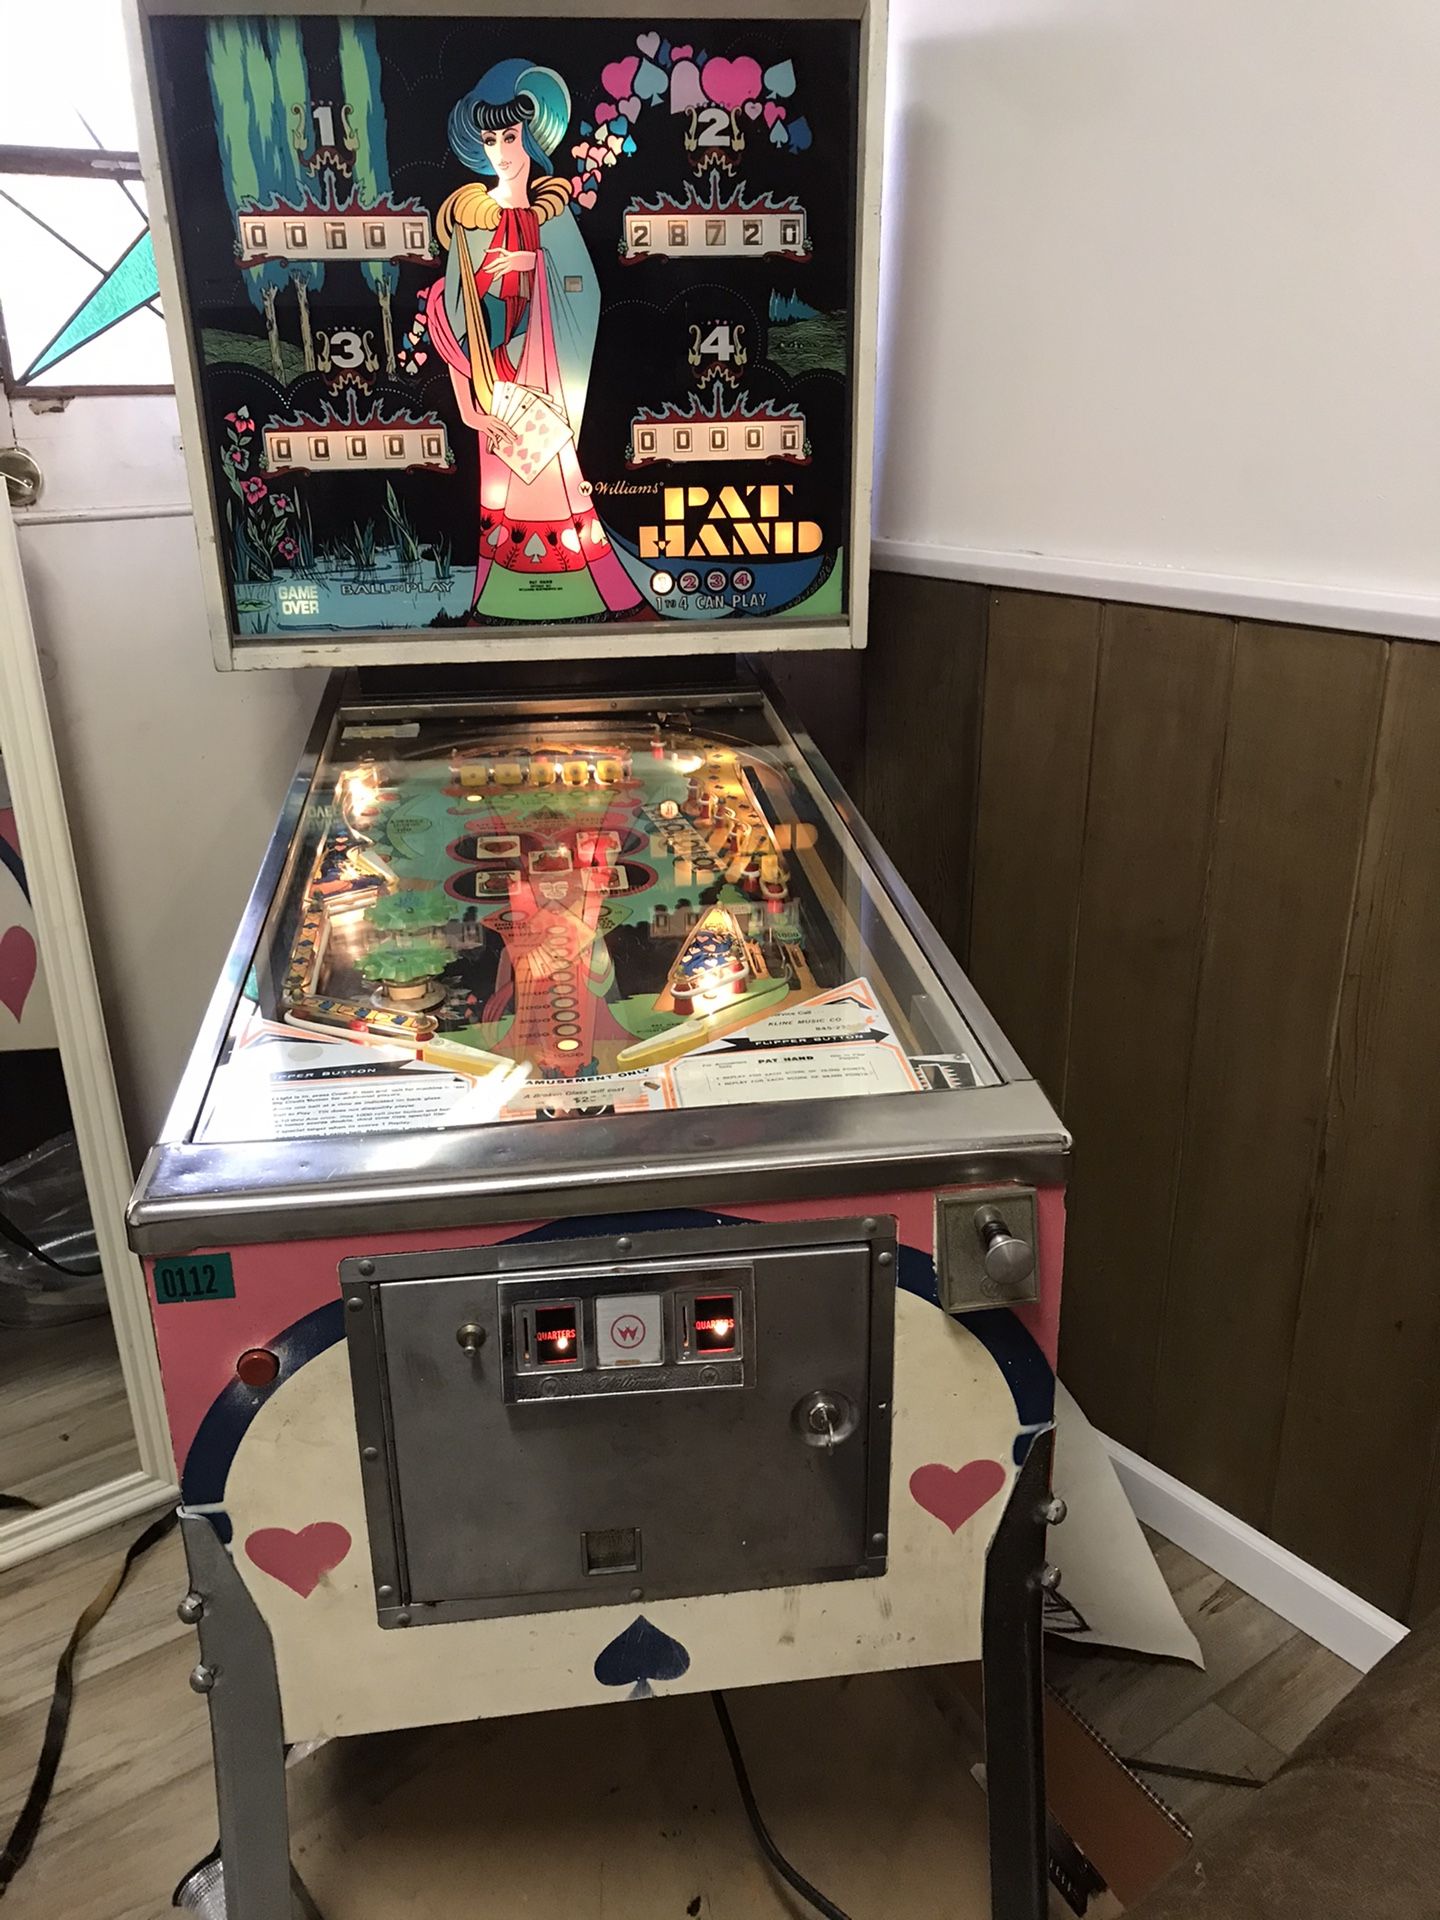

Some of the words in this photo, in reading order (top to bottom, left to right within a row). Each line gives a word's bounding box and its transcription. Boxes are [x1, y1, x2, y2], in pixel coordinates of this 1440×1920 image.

[313, 106, 335, 146] 1
[698, 108, 731, 146] 2
[330, 331, 365, 369] 3
[700, 325, 735, 361] 4
[594, 481, 660, 496] Williams
[664, 484, 794, 521] PAT
[638, 521, 824, 558] HAND
[340, 583, 390, 596] BALL
[404, 581, 455, 595] PLAY
[682, 574, 697, 588] 2
[709, 574, 724, 588] 3
[734, 573, 750, 587] 4
[278, 586, 319, 600] GAME
[282, 600, 320, 615] OVER
[679, 596, 689, 611] 4
[696, 595, 725, 610] CAN
[732, 593, 767, 608] PLAY
[814, 1034, 864, 1042] BUTTON
[321, 1067, 377, 1077] BUTTON
[525, 1075, 613, 1085] AMUSEMENT
[618, 1068, 649, 1078] ONLY
[161, 1264, 219, 1298] 0112
[695, 1318, 735, 1330] QUARTERS
[536, 1329, 576, 1341] QUARTERS
